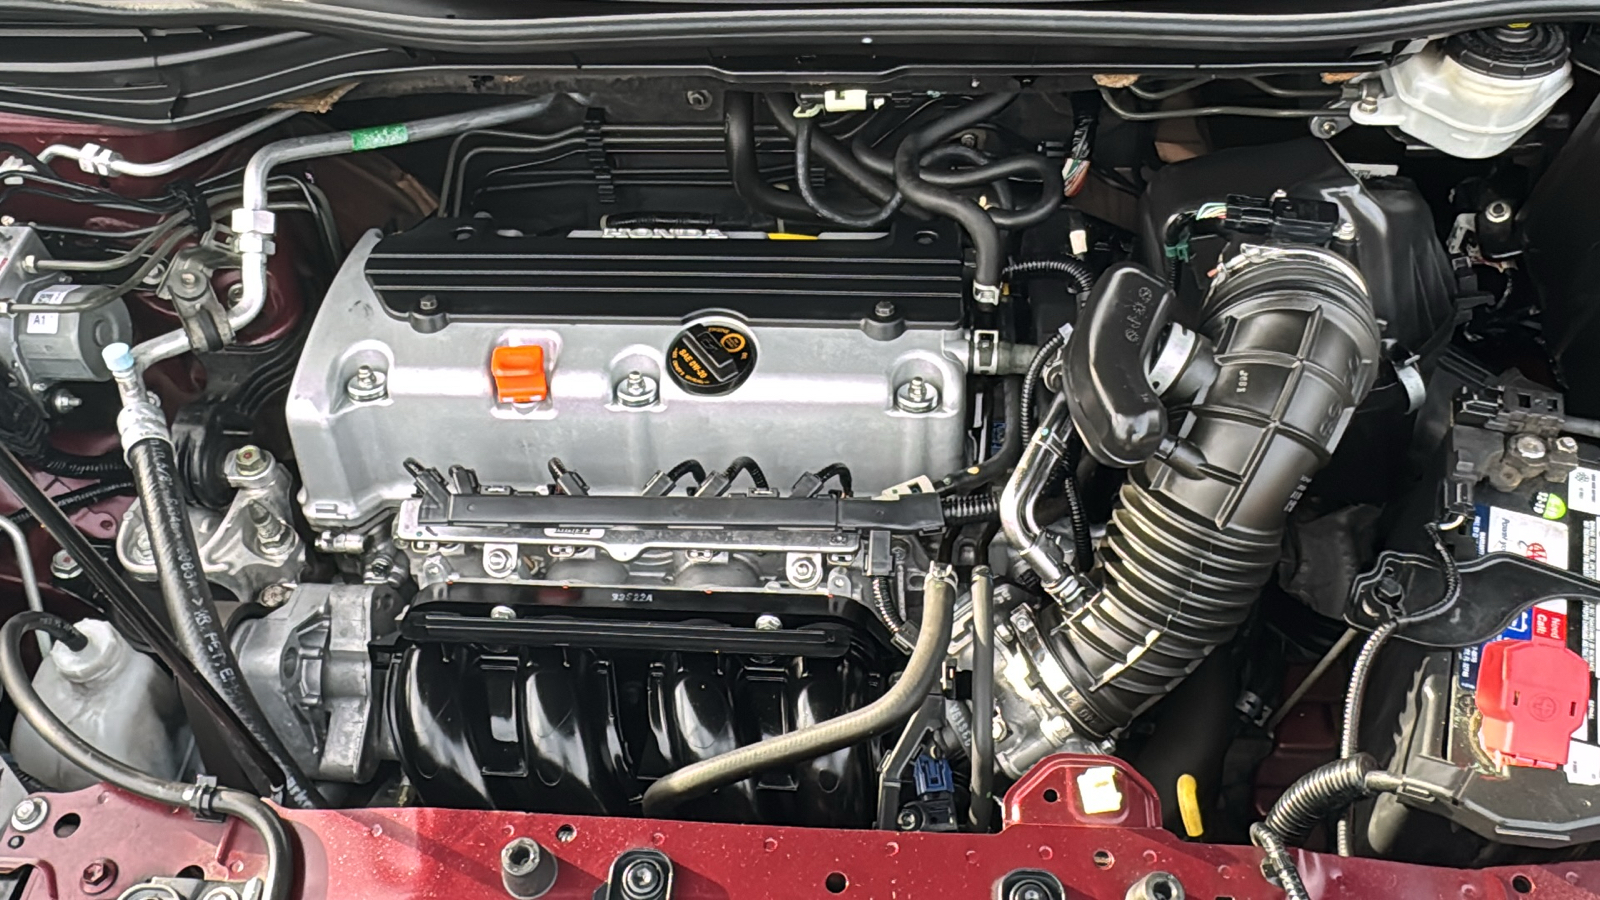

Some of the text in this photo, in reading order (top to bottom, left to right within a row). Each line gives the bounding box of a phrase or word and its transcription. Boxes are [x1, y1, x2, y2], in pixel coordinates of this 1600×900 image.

[602, 227, 728, 239] HONDA
[1536, 613, 1548, 635] Call:
[1550, 617, 1562, 640] Need
